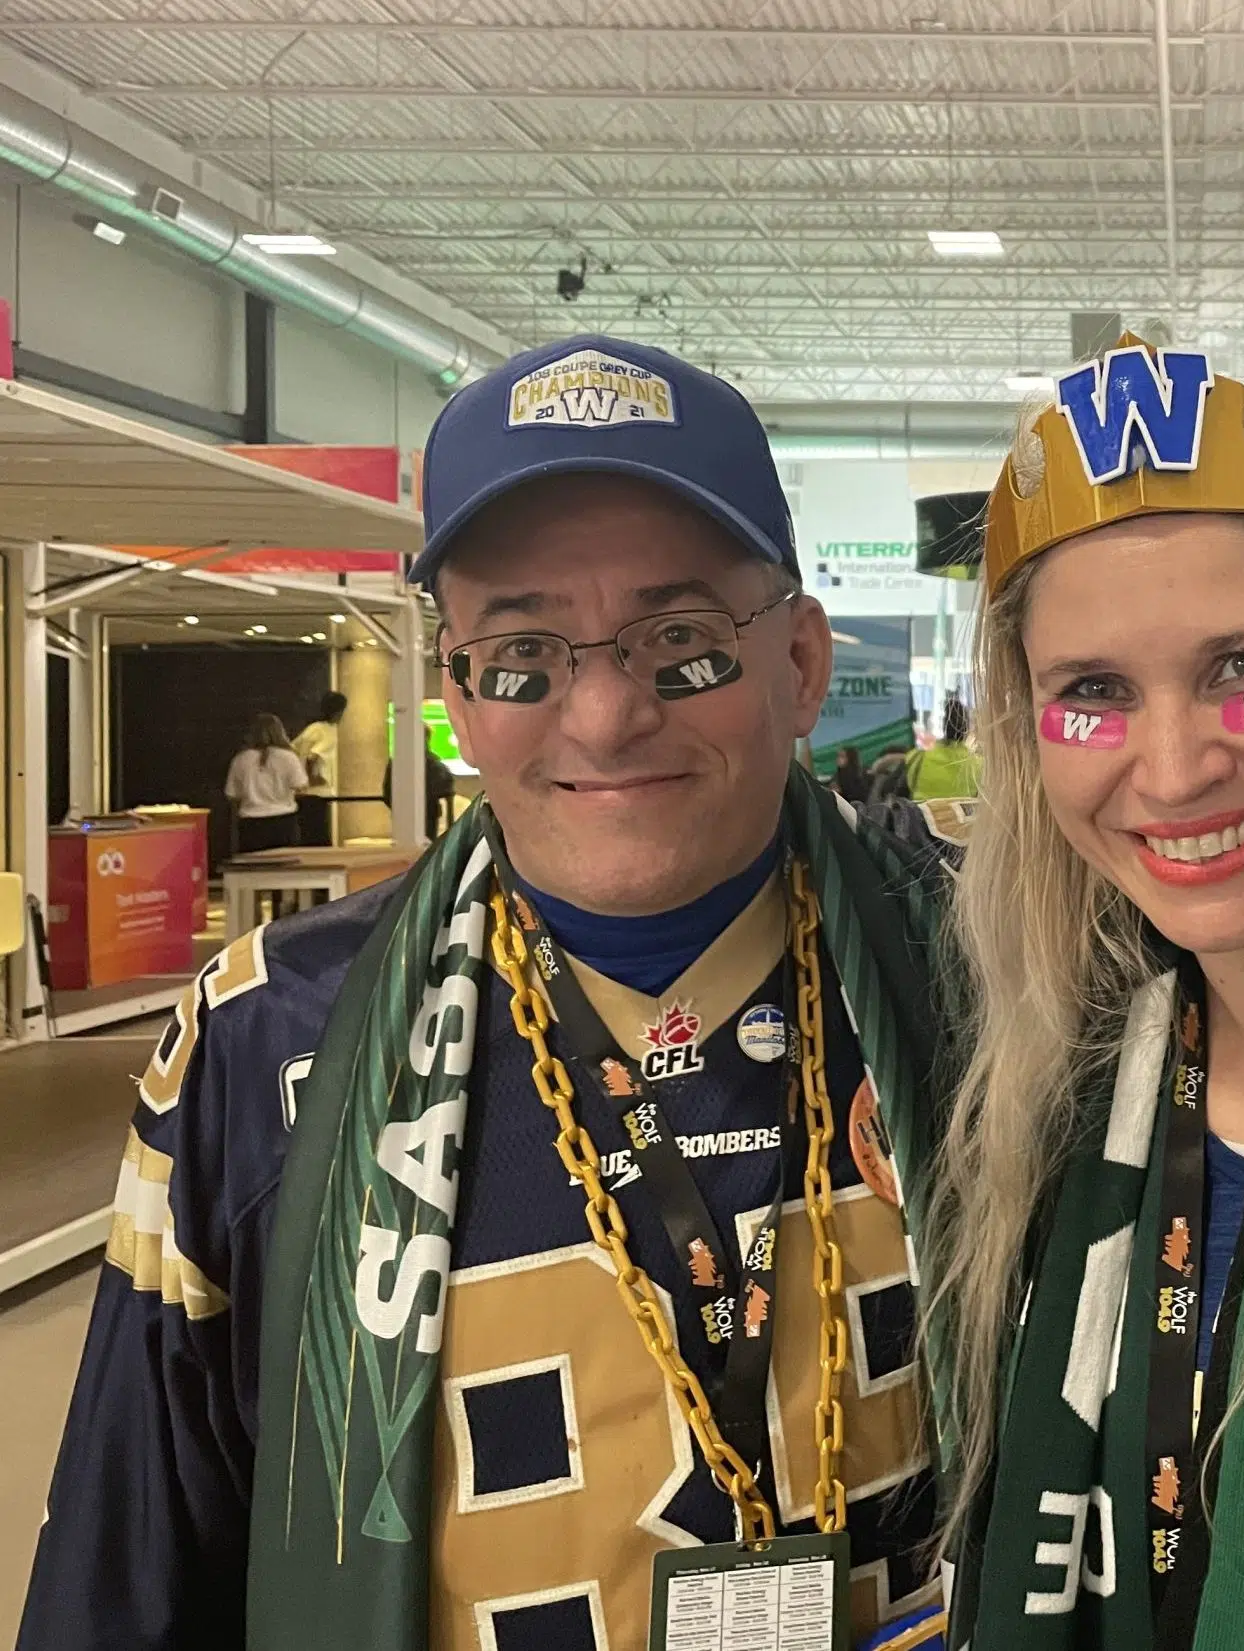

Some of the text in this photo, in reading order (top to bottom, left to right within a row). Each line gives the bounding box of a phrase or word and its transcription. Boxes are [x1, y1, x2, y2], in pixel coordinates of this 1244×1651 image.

[553, 360, 598, 377] COUPE
[600, 361, 627, 376] GREY
[629, 367, 653, 380] CUP
[512, 371, 669, 422] CHAMPIONS
[535, 404, 645, 420] 20 21
[560, 386, 619, 423] W
[1055, 344, 1215, 487] W
[494, 671, 529, 697] W
[679, 658, 718, 689] W
[837, 675, 892, 697] ZONE
[1063, 710, 1102, 742] W
[540, 936, 560, 976] WOLF
[644, 1045, 704, 1080] CFL
[1184, 1066, 1199, 1110] WOLF
[634, 1102, 663, 1144] WOLF
[675, 1126, 780, 1158] BOMBERS
[751, 1227, 769, 1271] WOLF
[1171, 1286, 1188, 1334] WOLF
